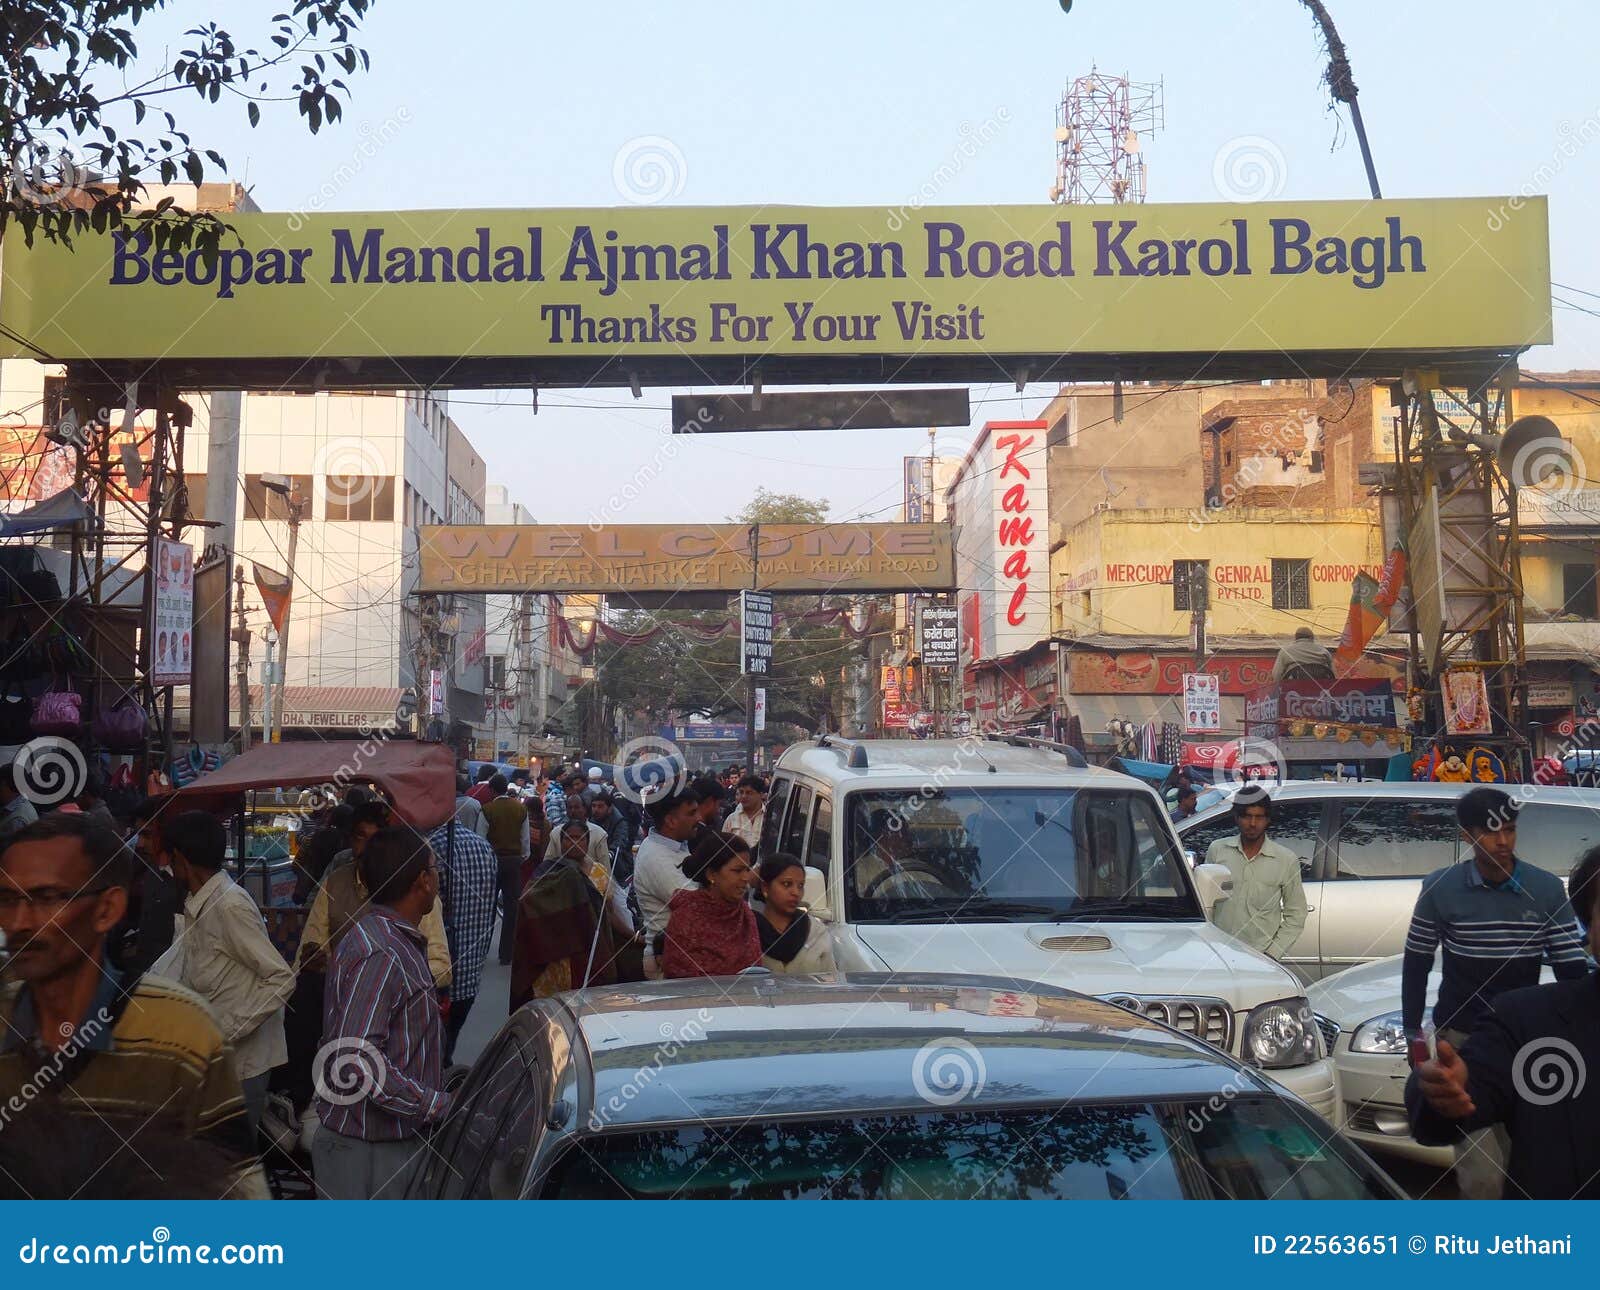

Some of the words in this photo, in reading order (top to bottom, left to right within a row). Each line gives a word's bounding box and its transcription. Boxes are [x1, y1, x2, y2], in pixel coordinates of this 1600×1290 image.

[109, 230, 312, 298] Beopar
[332, 227, 543, 284] Mandal
[560, 226, 730, 296] Ajmal
[751, 225, 905, 279] Khan
[924, 222, 1074, 278] Road
[1094, 219, 1251, 277] Karol
[1271, 217, 1426, 289] Bagh
[541, 304, 696, 343] Thanks
[711, 303, 771, 342] For
[786, 303, 881, 342] Your
[892, 301, 985, 341] Visit
[440, 530, 936, 558] WELCOME
[996, 433, 1034, 627] Kamal
[459, 560, 595, 585] GHAFFAR
[605, 560, 727, 584] MARKET
[811, 559, 872, 574] KHAN
[878, 558, 939, 573] ROAD
[1106, 564, 1174, 583] MERCURY
[1214, 565, 1271, 584] GENRAL
[1164, 661, 1231, 685] Chat
[307, 713, 368, 726] JEWELLERS
[1285, 689, 1334, 718] दिल्ली
[1335, 689, 1389, 722] पुलिस
